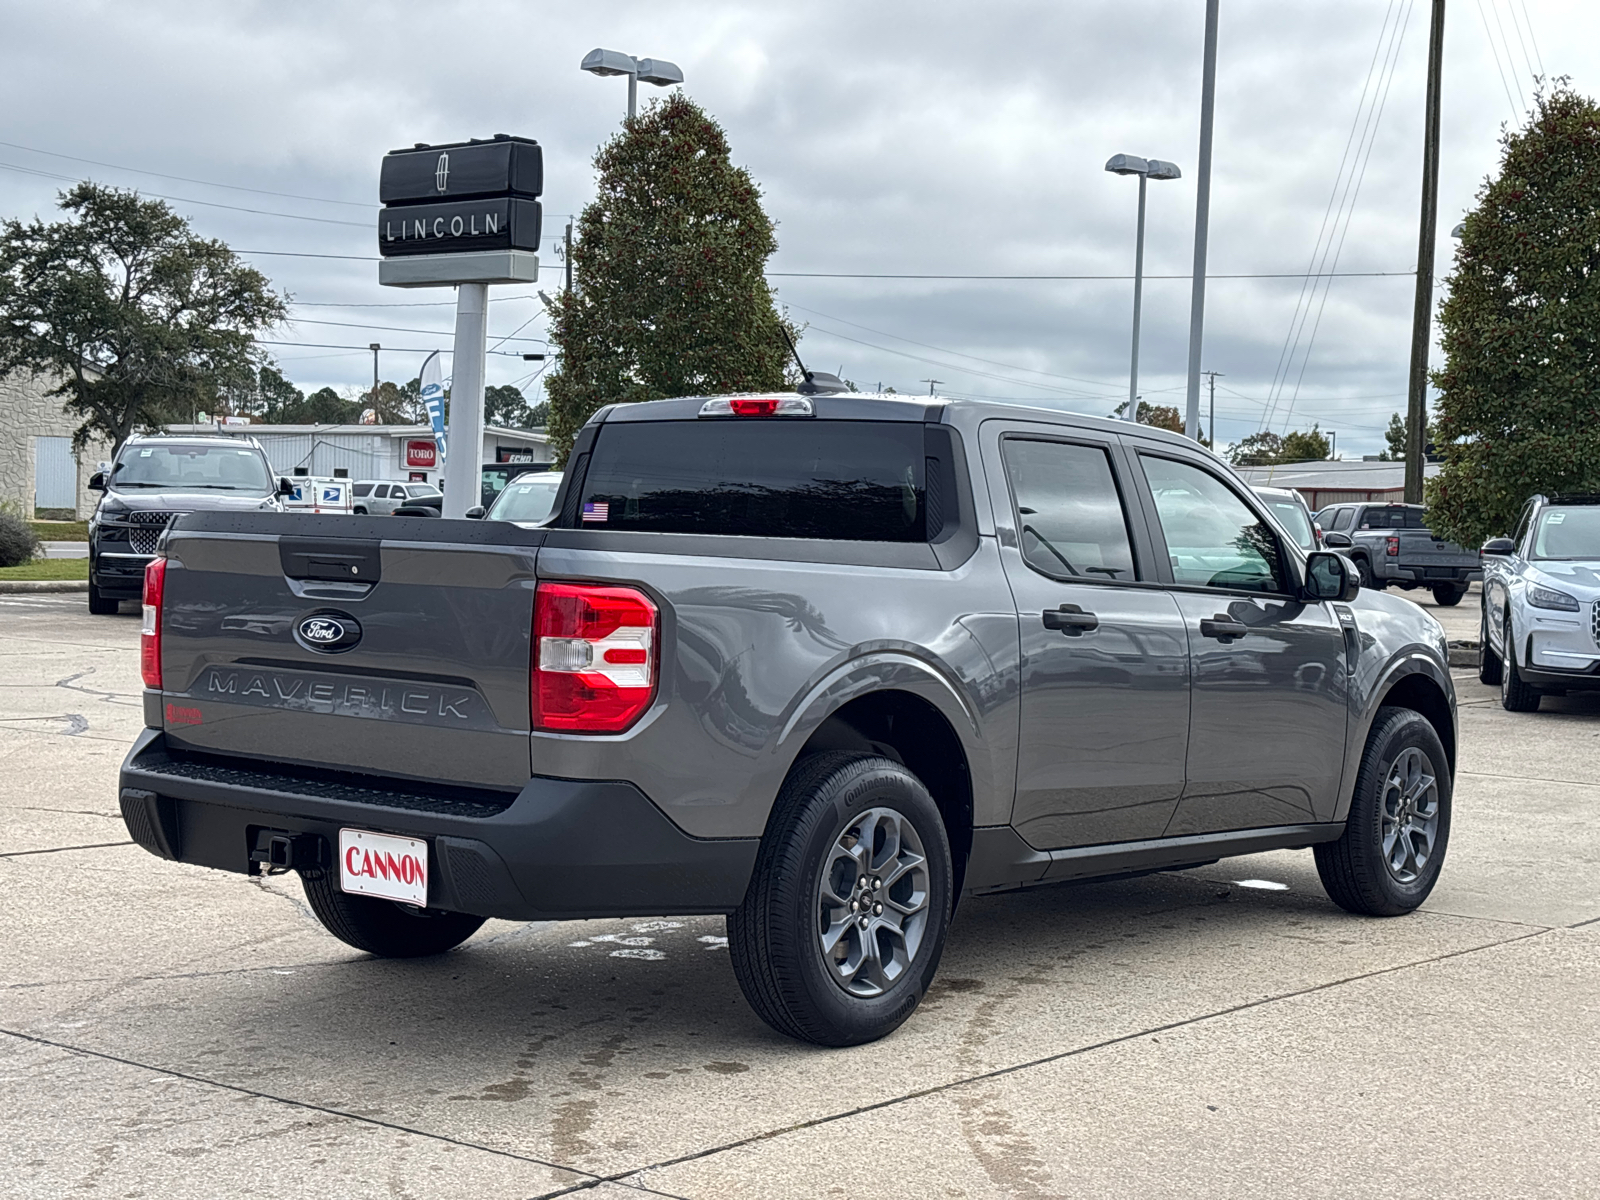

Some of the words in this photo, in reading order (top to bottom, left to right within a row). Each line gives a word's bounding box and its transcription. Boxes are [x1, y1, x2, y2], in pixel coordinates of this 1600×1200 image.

[386, 213, 498, 241] LINCOLN
[409, 449, 433, 459] TORO
[509, 454, 532, 462] ECHO
[306, 620, 336, 640] Ford
[208, 671, 470, 719] MAVERICK
[843, 774, 898, 807] Continental
[345, 846, 425, 889] CANNON
